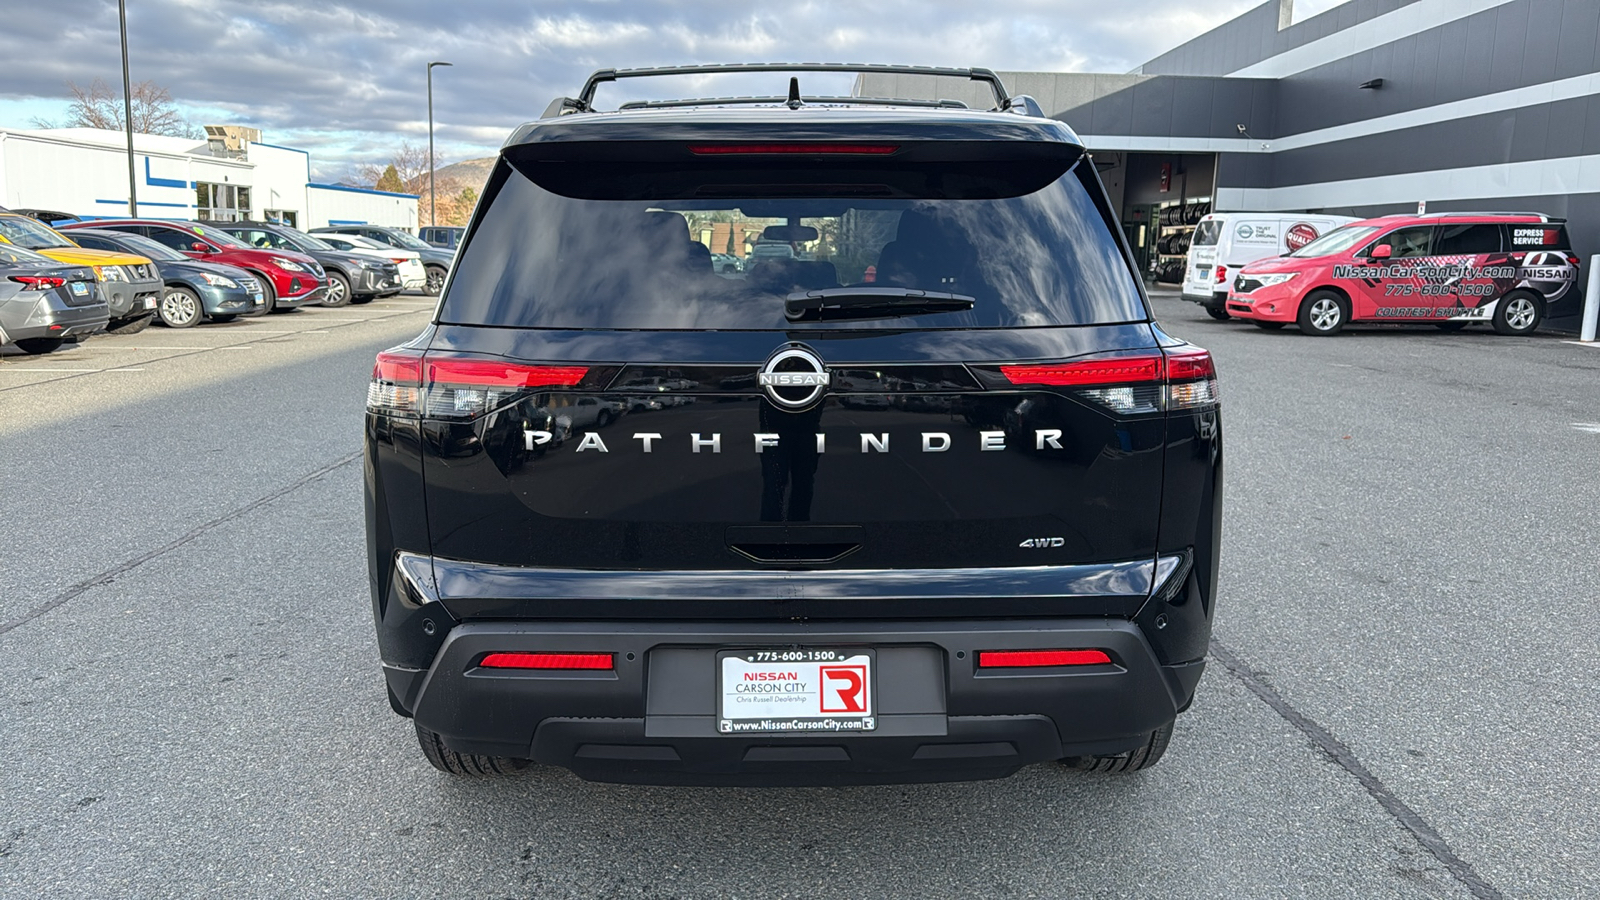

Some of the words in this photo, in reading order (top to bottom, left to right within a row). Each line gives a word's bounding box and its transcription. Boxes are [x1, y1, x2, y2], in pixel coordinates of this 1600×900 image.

[1513, 229, 1544, 237] EXPRESS
[1513, 237, 1544, 245] SERVICE
[1332, 264, 1515, 280] NissanCarsonCity.com
[1523, 269, 1571, 279] NISSAN
[1384, 283, 1495, 297] 775-600-1500
[1376, 307, 1434, 317] COURTESY
[1435, 307, 1486, 317] SHUTTLE
[761, 375, 828, 384] NISSAN
[523, 428, 1064, 453] PATHFINDER
[1019, 537, 1065, 548] 4WD
[757, 651, 836, 661] 775-600-1500
[744, 672, 798, 681] NISSAN
[735, 683, 782, 693] CARSON
[784, 683, 807, 692] CITY
[774, 695, 807, 704] Dealership
[733, 719, 862, 732] www.NissanCarsonCity.com
